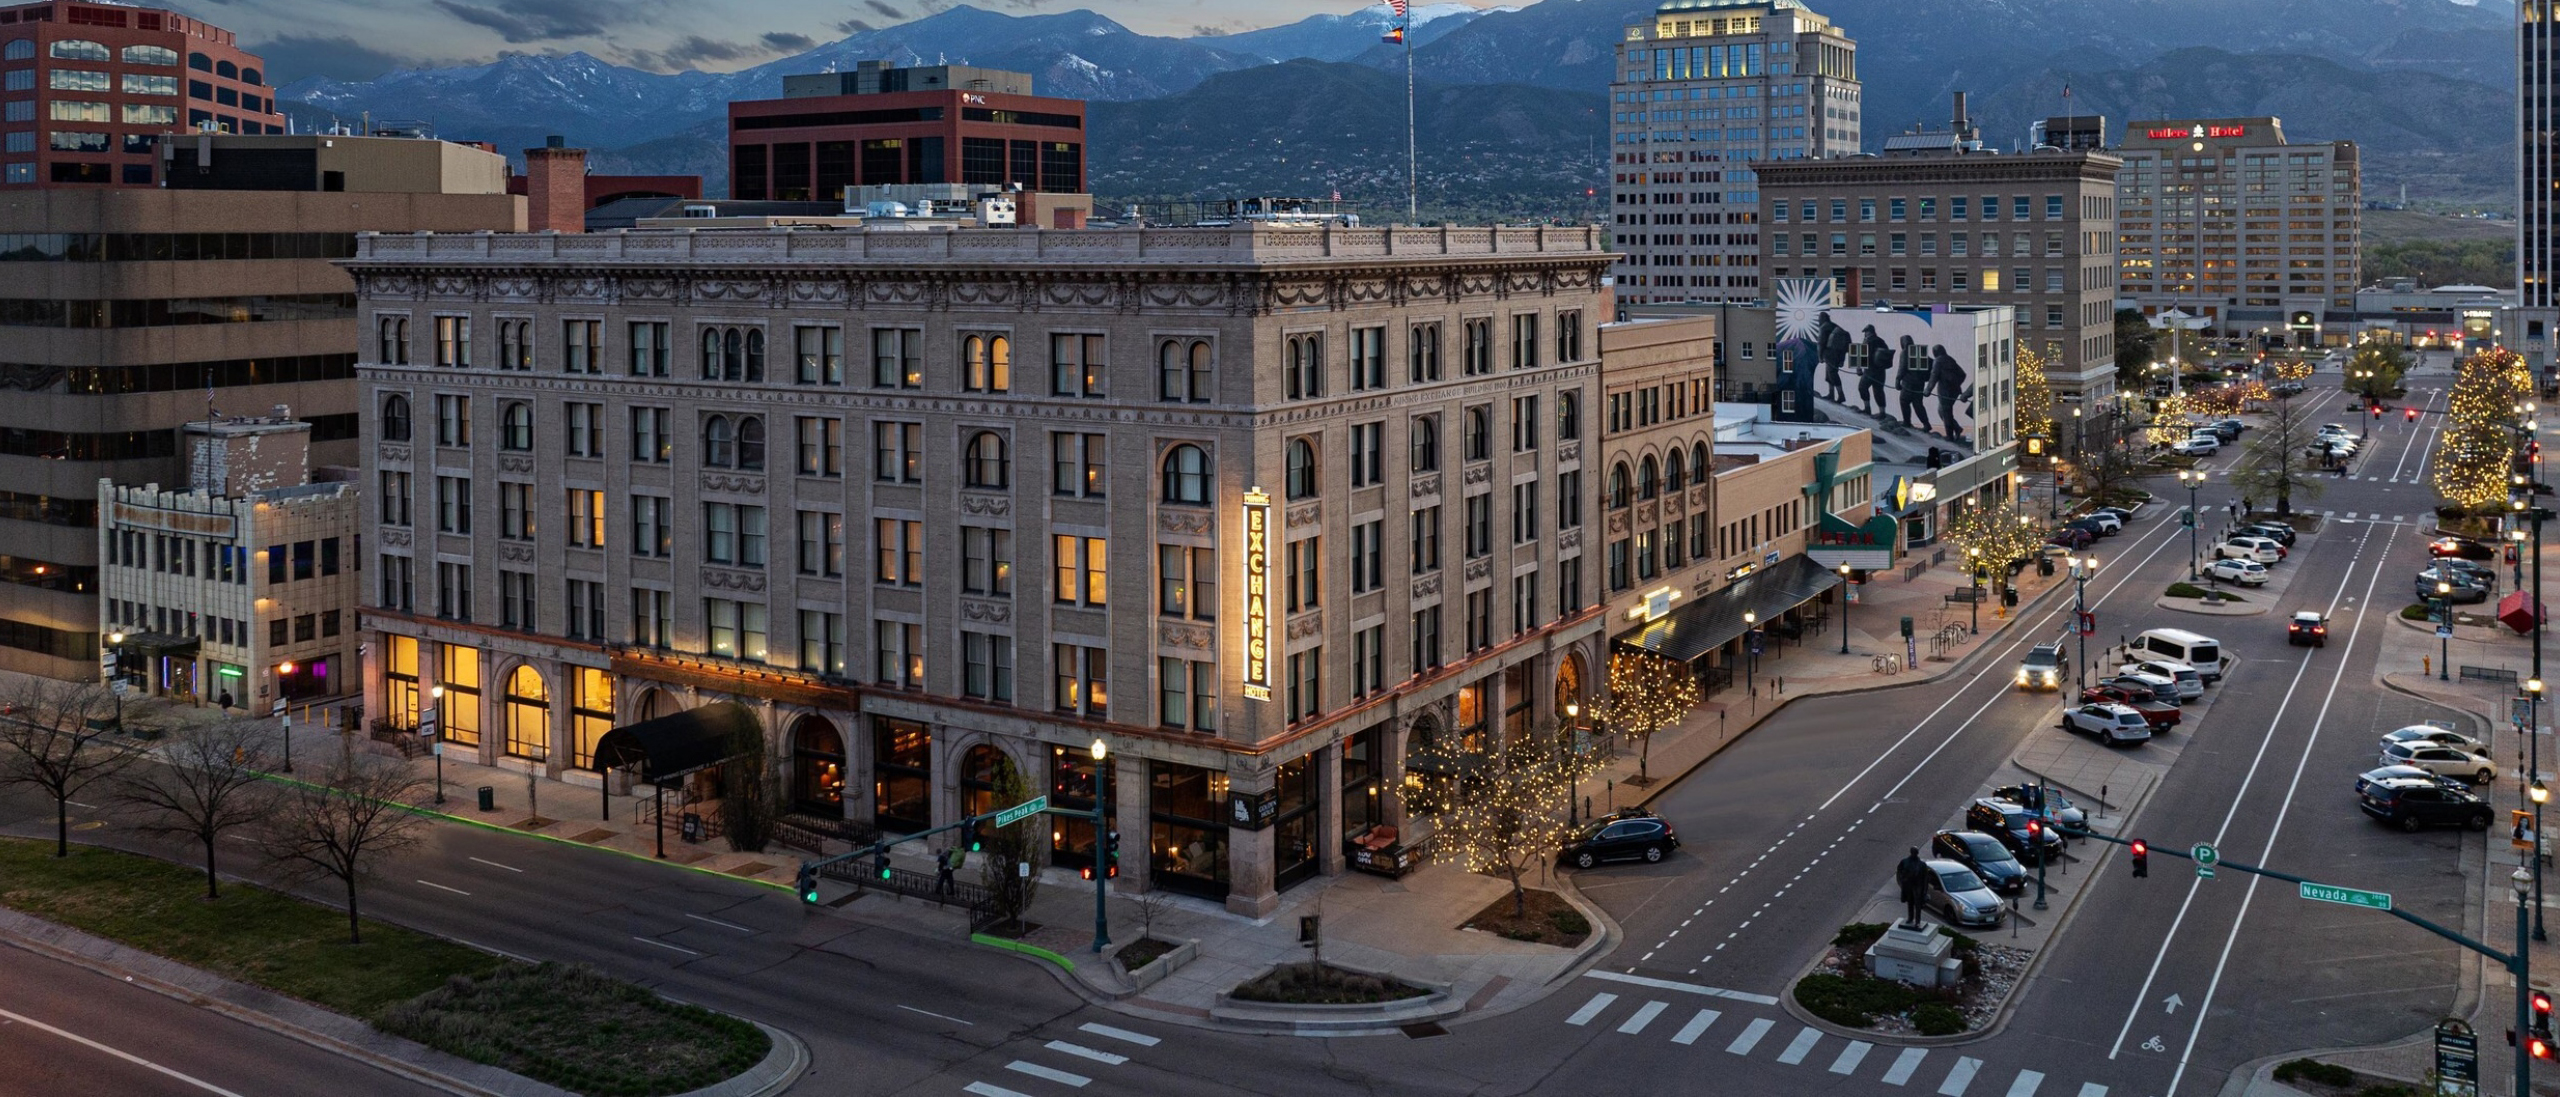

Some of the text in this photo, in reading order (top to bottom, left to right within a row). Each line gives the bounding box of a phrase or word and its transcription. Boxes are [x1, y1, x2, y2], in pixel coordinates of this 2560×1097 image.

[970, 94, 985, 105] PNC
[2147, 124, 2244, 139] Antlers Hotel
[1420, 388, 1461, 402] EXCHANGE
[1463, 383, 1492, 395] BUILDING
[1821, 531, 1875, 546] PEAK
[1249, 510, 1265, 681] EXCHANGE
[1245, 685, 1270, 699] HOTEL
[998, 805, 1028, 825] Pikes Peak
[2199, 847, 2211, 861] P
[2303, 885, 2347, 901] Nevada
